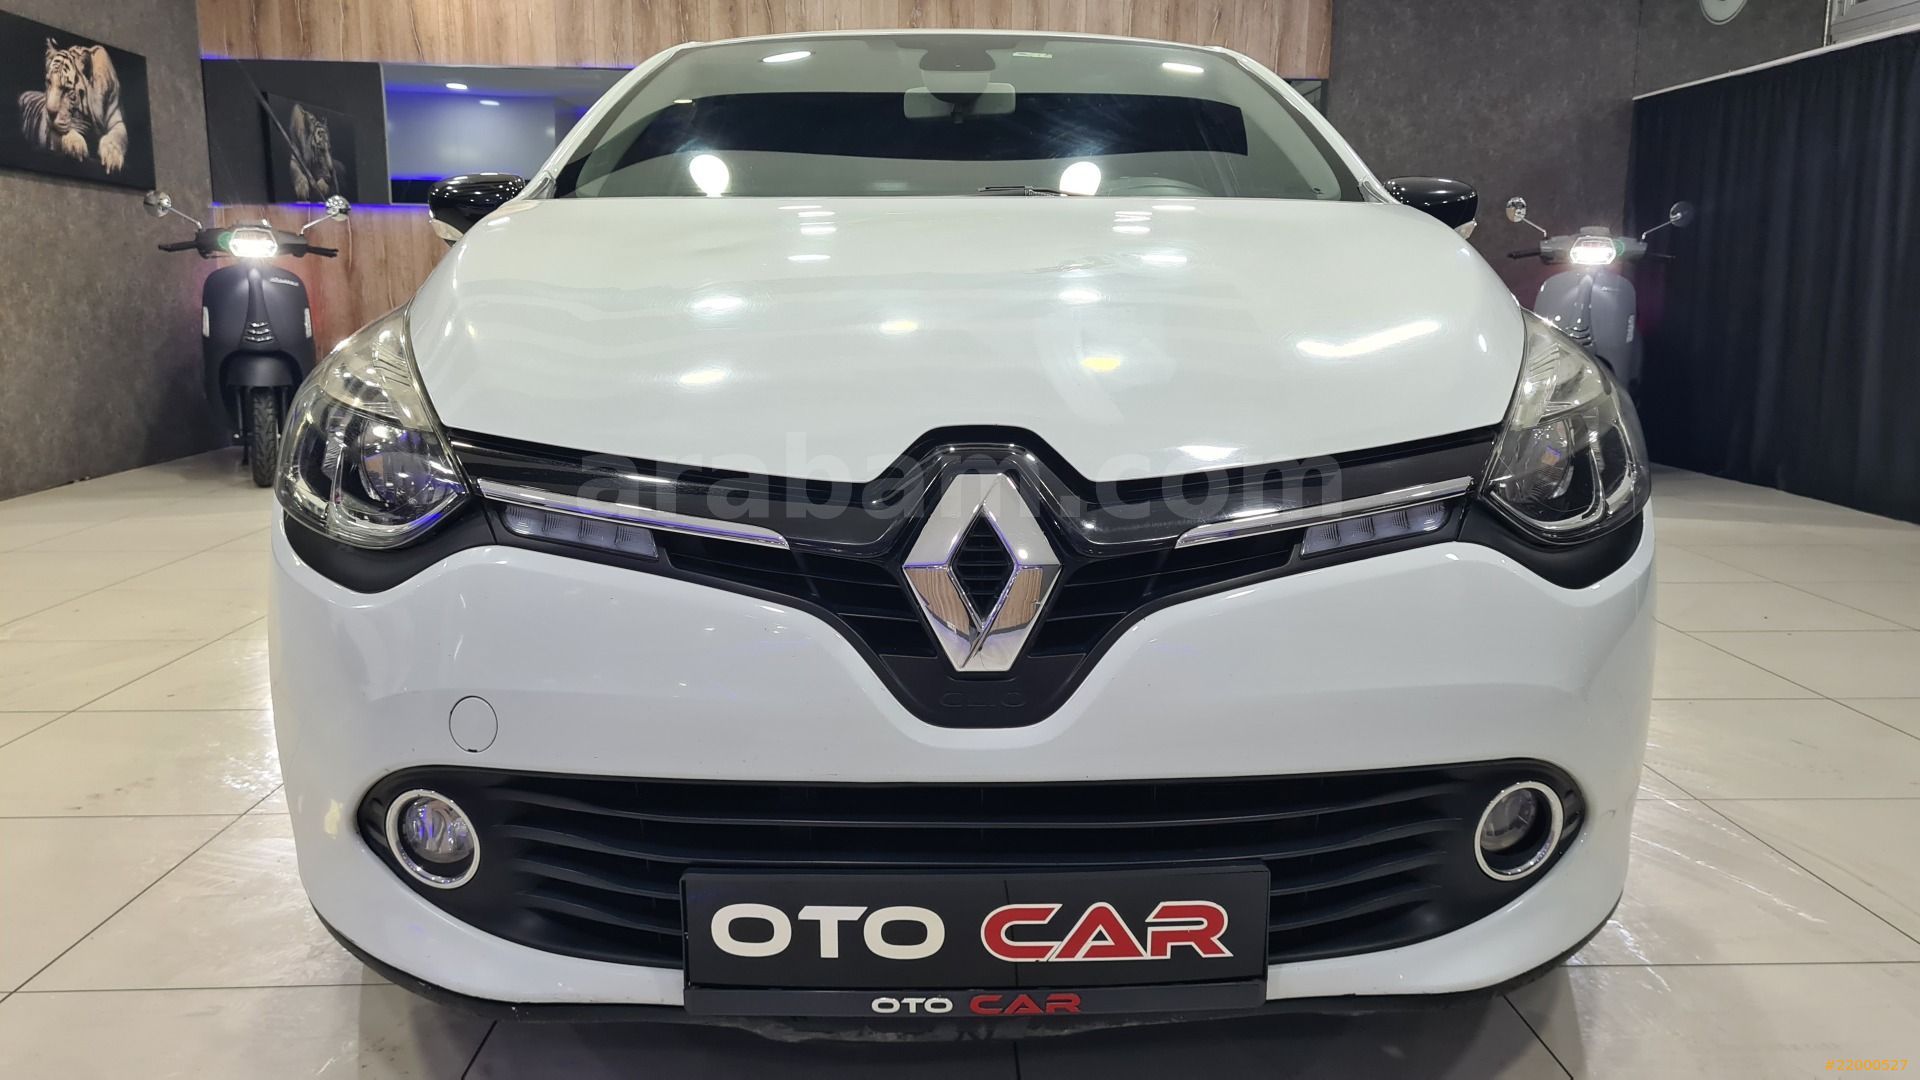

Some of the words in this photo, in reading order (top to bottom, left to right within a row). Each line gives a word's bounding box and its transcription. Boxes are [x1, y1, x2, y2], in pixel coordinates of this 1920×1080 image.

[710, 903, 945, 960] OTO
[980, 901, 1233, 963] CAR
[871, 996, 953, 1014] OTO
[969, 993, 1081, 1015] CAR
